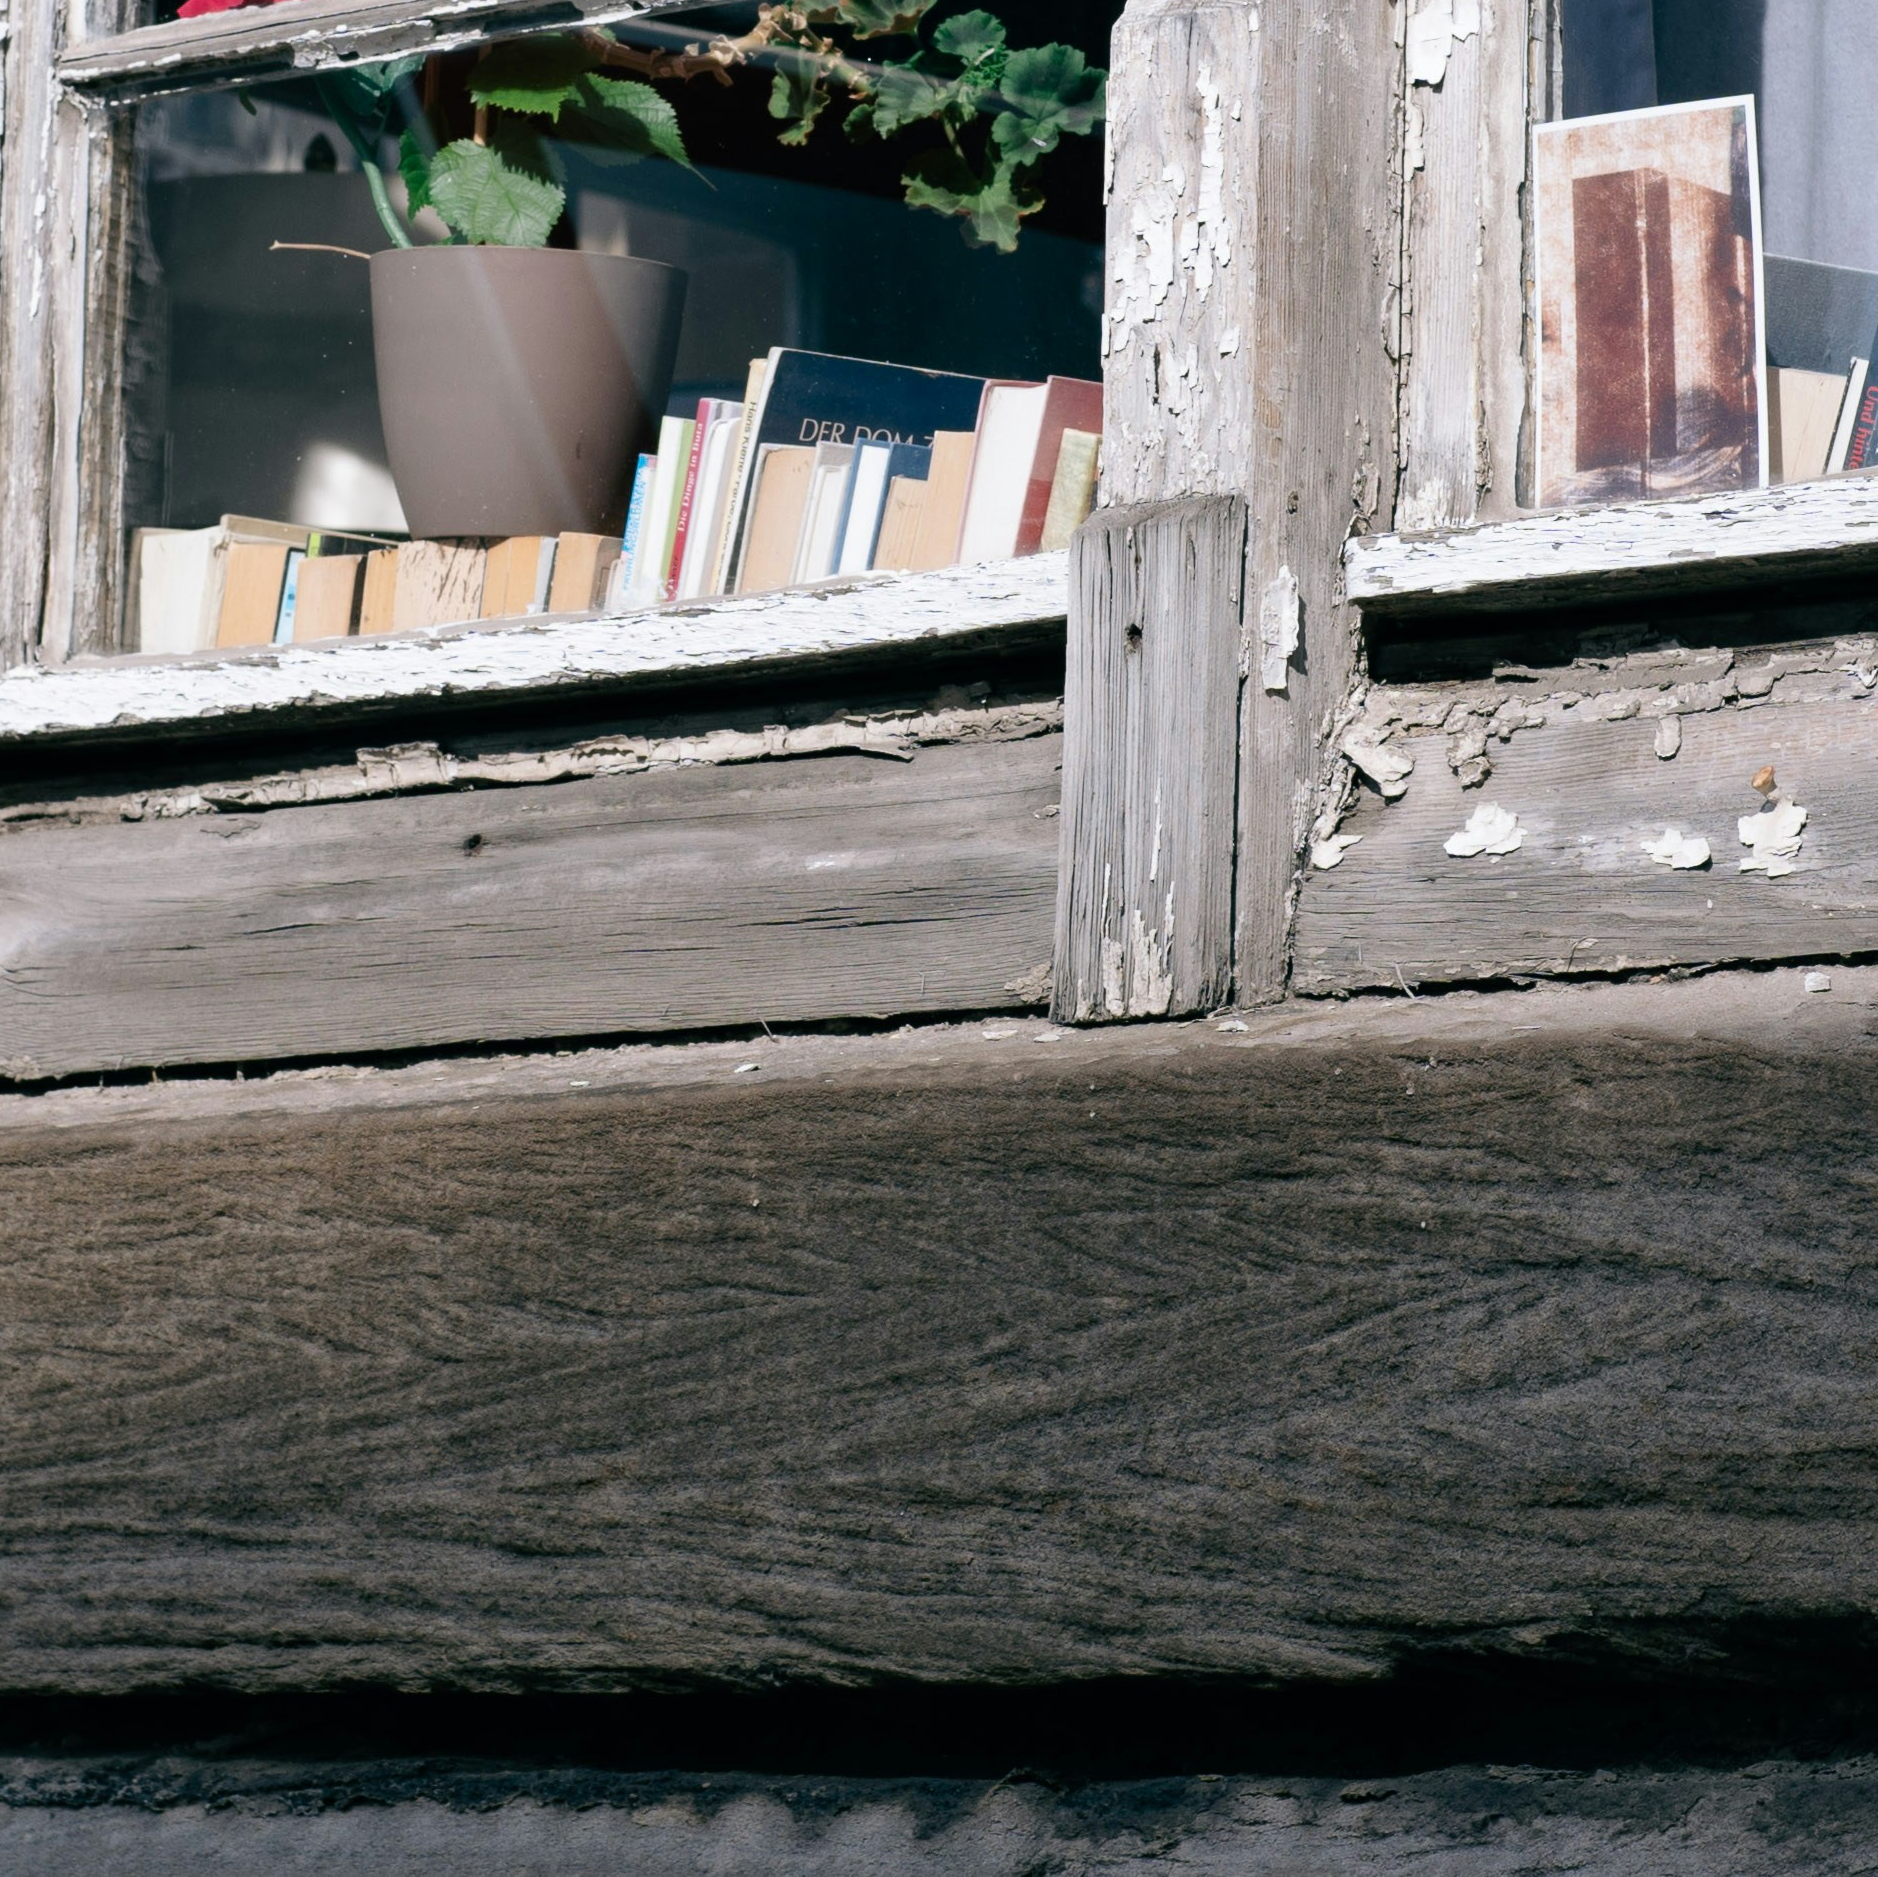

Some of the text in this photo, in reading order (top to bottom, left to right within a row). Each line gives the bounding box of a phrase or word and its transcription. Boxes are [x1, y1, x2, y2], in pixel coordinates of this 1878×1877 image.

[744, 401, 758, 435] Hans
[799, 418, 845, 443] DER
[681, 472, 696, 506] Dinge
[689, 455, 699, 468] in
